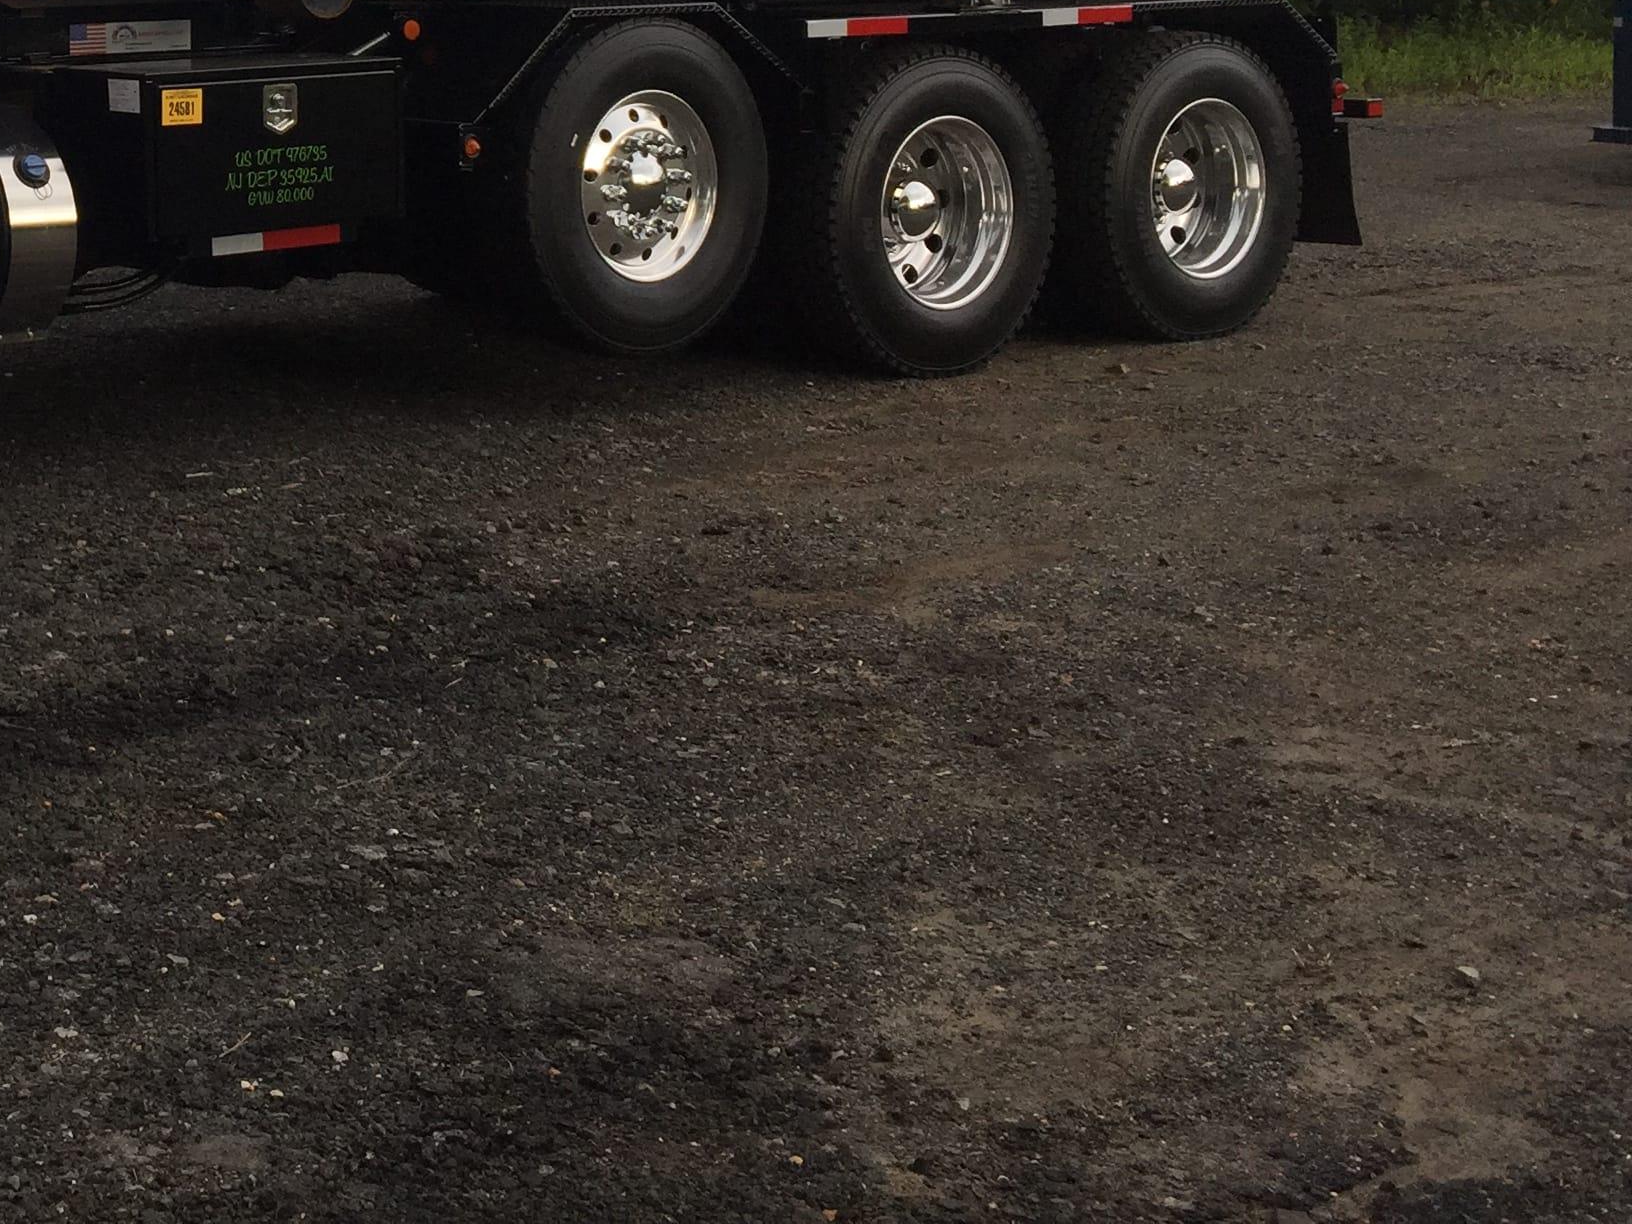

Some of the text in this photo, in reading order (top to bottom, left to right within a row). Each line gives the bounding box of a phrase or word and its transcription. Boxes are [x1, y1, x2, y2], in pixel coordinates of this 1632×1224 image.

[168, 101, 196, 117] 24581
[235, 150, 253, 168] US
[256, 148, 286, 166] DOT
[225, 172, 243, 191] NJ
[248, 169, 279, 188] DEP
[248, 190, 276, 207] GVW
